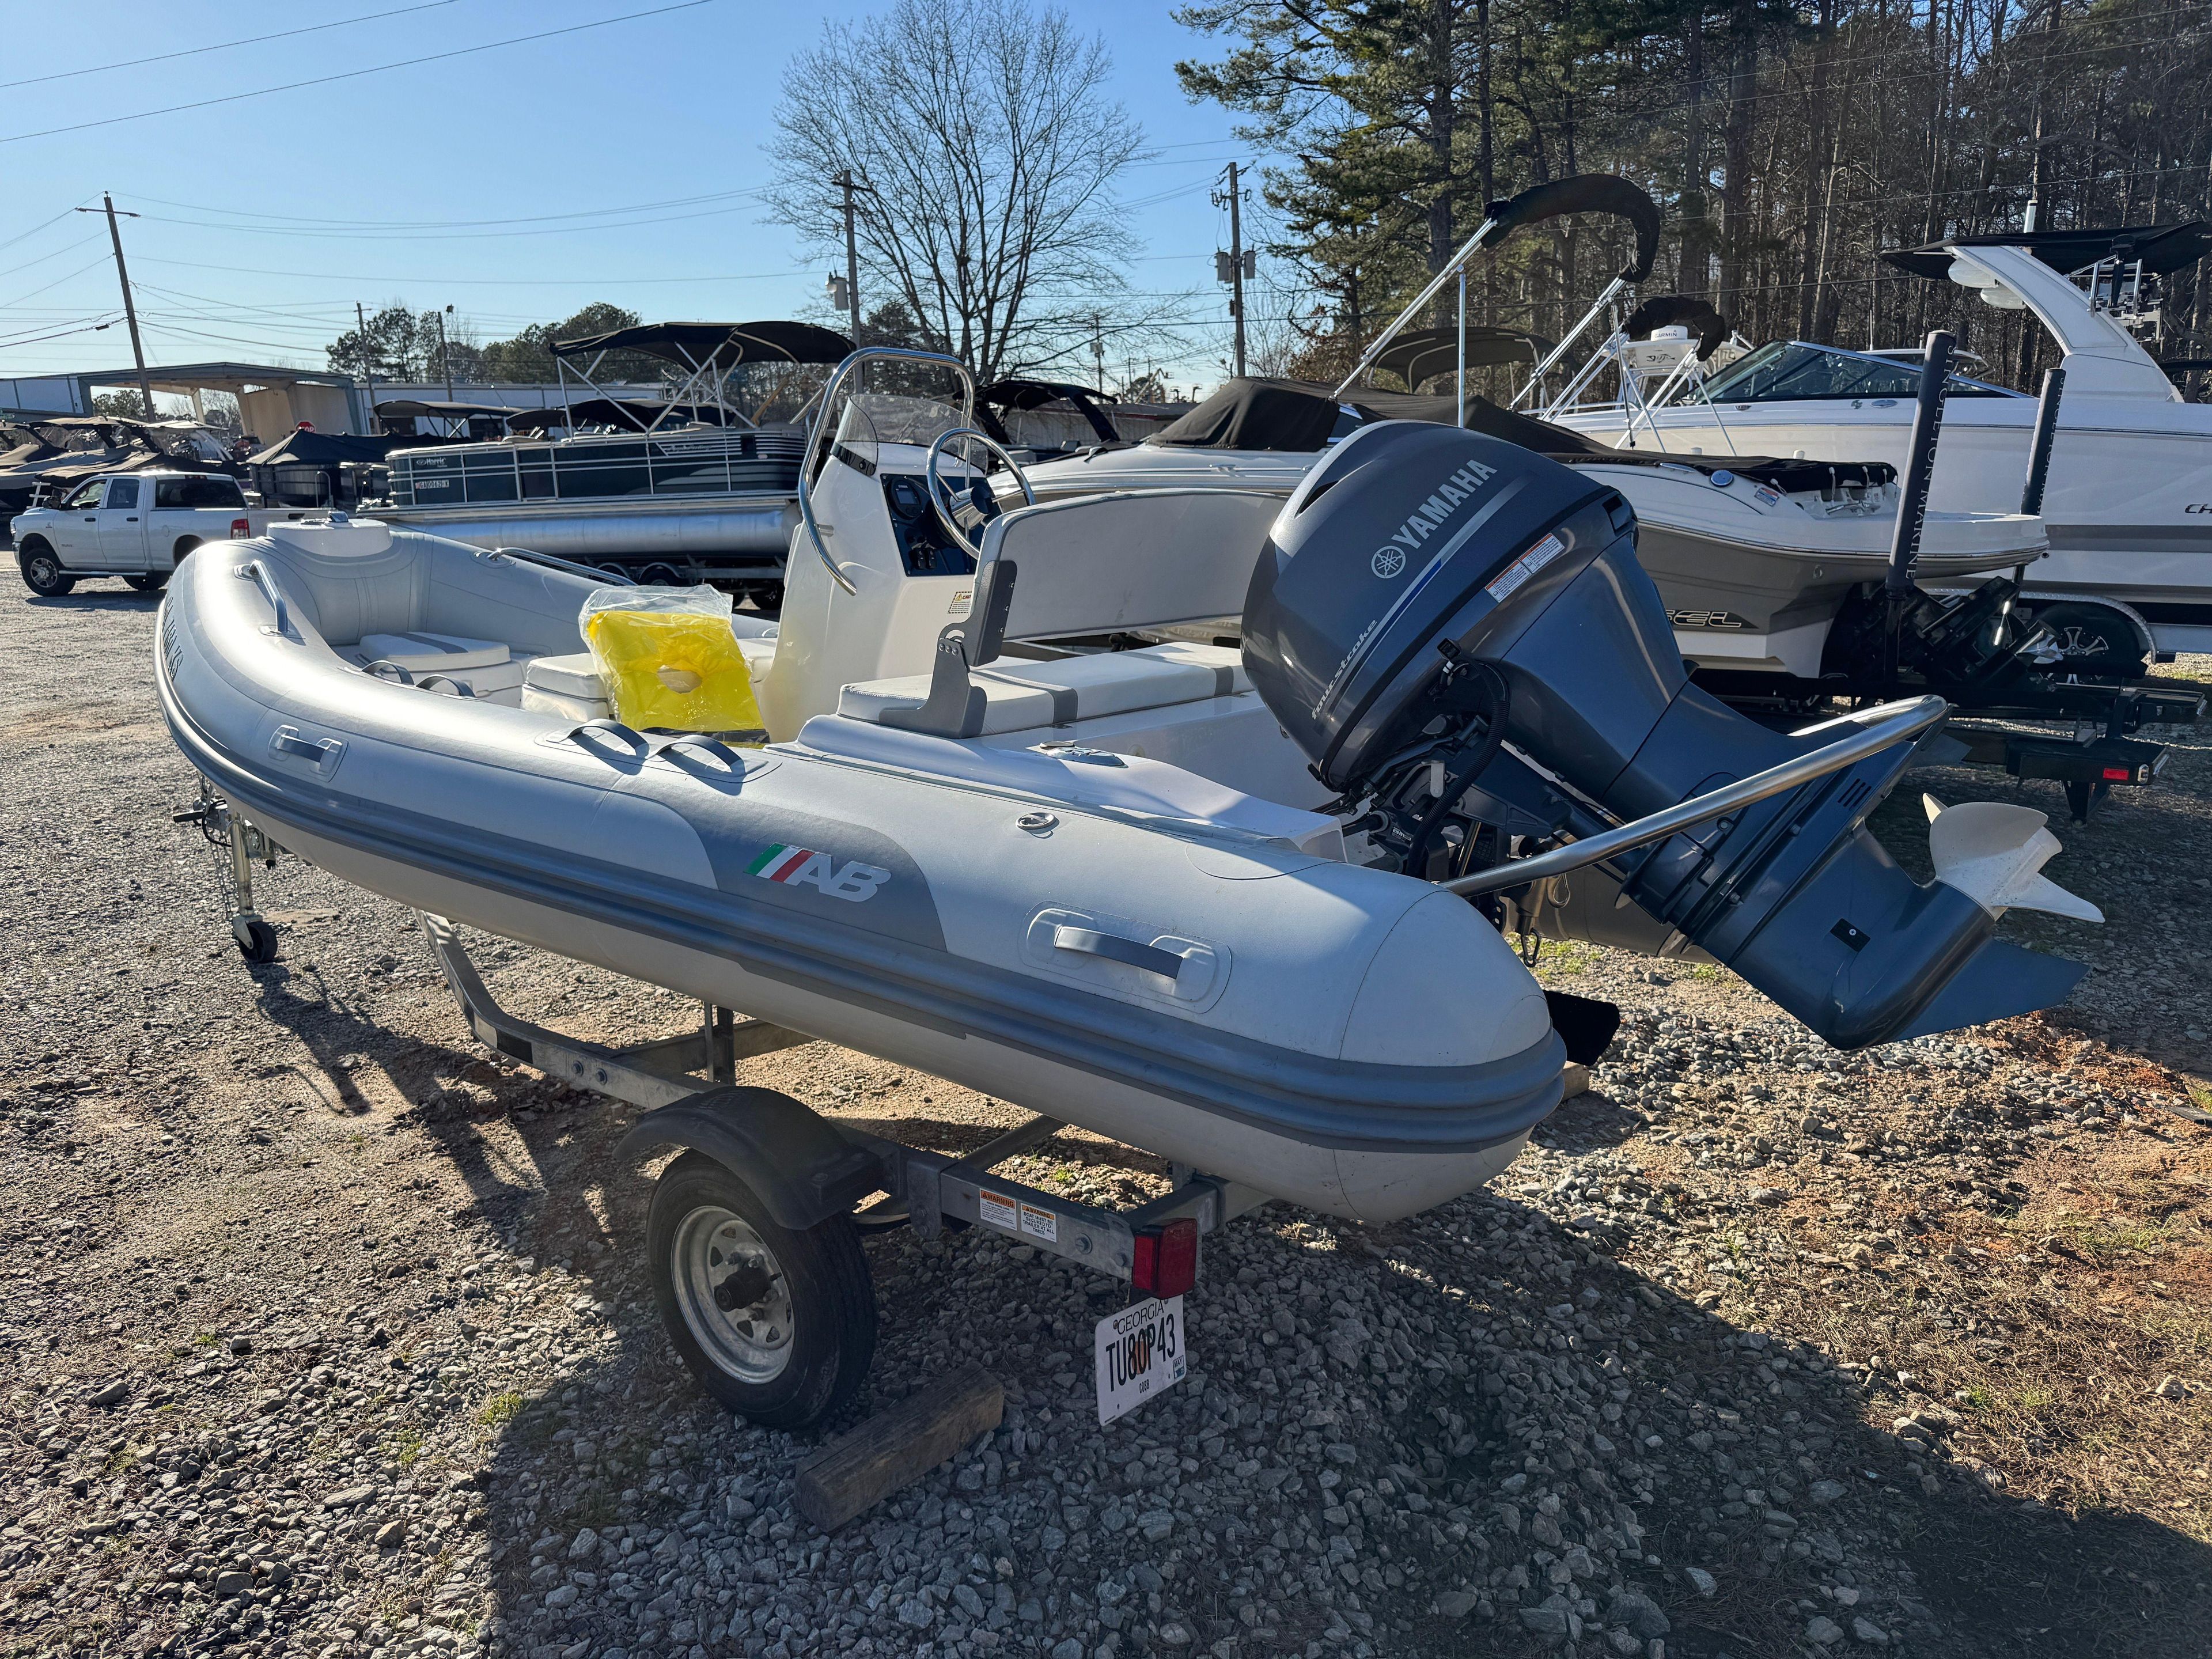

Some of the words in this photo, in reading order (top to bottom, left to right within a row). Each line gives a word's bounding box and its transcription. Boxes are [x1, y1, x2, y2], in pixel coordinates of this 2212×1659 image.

[1391, 460, 1498, 549] YAMAHA
[1905, 487, 1929, 579] MARINE
[783, 852, 892, 903] AB
[987, 1192, 1014, 1207] WARNING
[1023, 1219, 1040, 1229] TRAILER
[1025, 1217, 1045, 1226] SECURED
[1032, 1227, 1045, 1235] TIMES
[1118, 1301, 1164, 1335] GEORGIA
[1105, 1313, 1176, 1392] TU80P43
[1174, 1357, 1183, 1367] MAY
[1139, 1379, 1150, 1394] COBB
